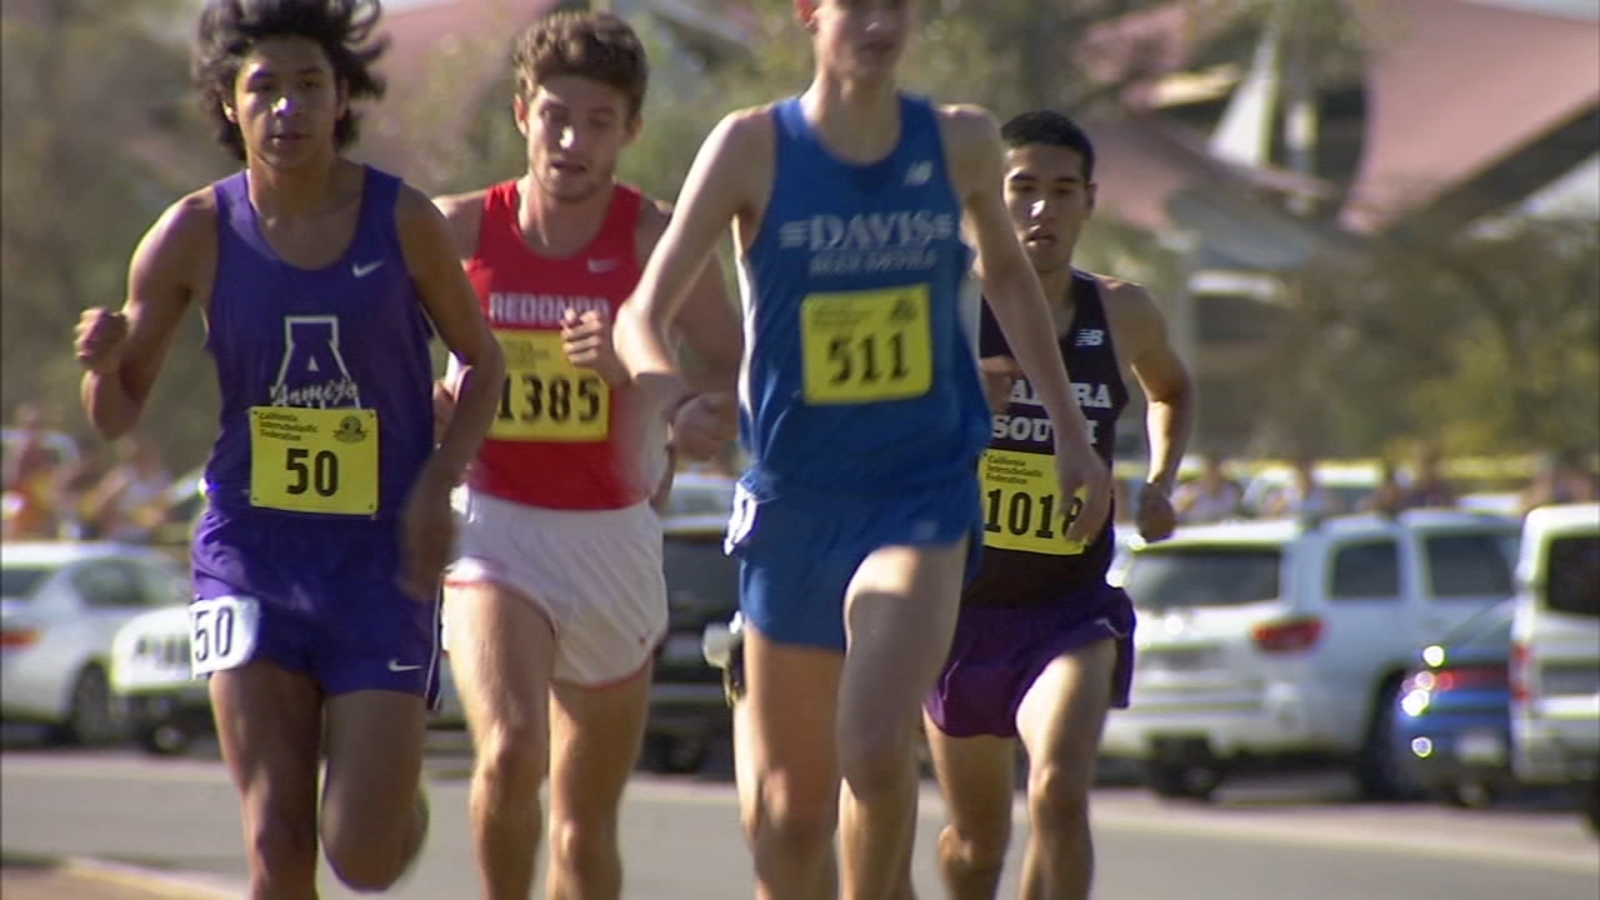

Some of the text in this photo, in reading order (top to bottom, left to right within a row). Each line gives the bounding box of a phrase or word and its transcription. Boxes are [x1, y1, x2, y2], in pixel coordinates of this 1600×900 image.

[809, 210, 933, 252] DAVIS
[827, 330, 910, 384] 511
[259, 410, 298, 423] California
[497, 373, 601, 423] 1385
[993, 415, 1098, 444] SOU
[285, 447, 340, 498] 50
[987, 454, 1027, 468] California
[194, 606, 234, 662] 50
